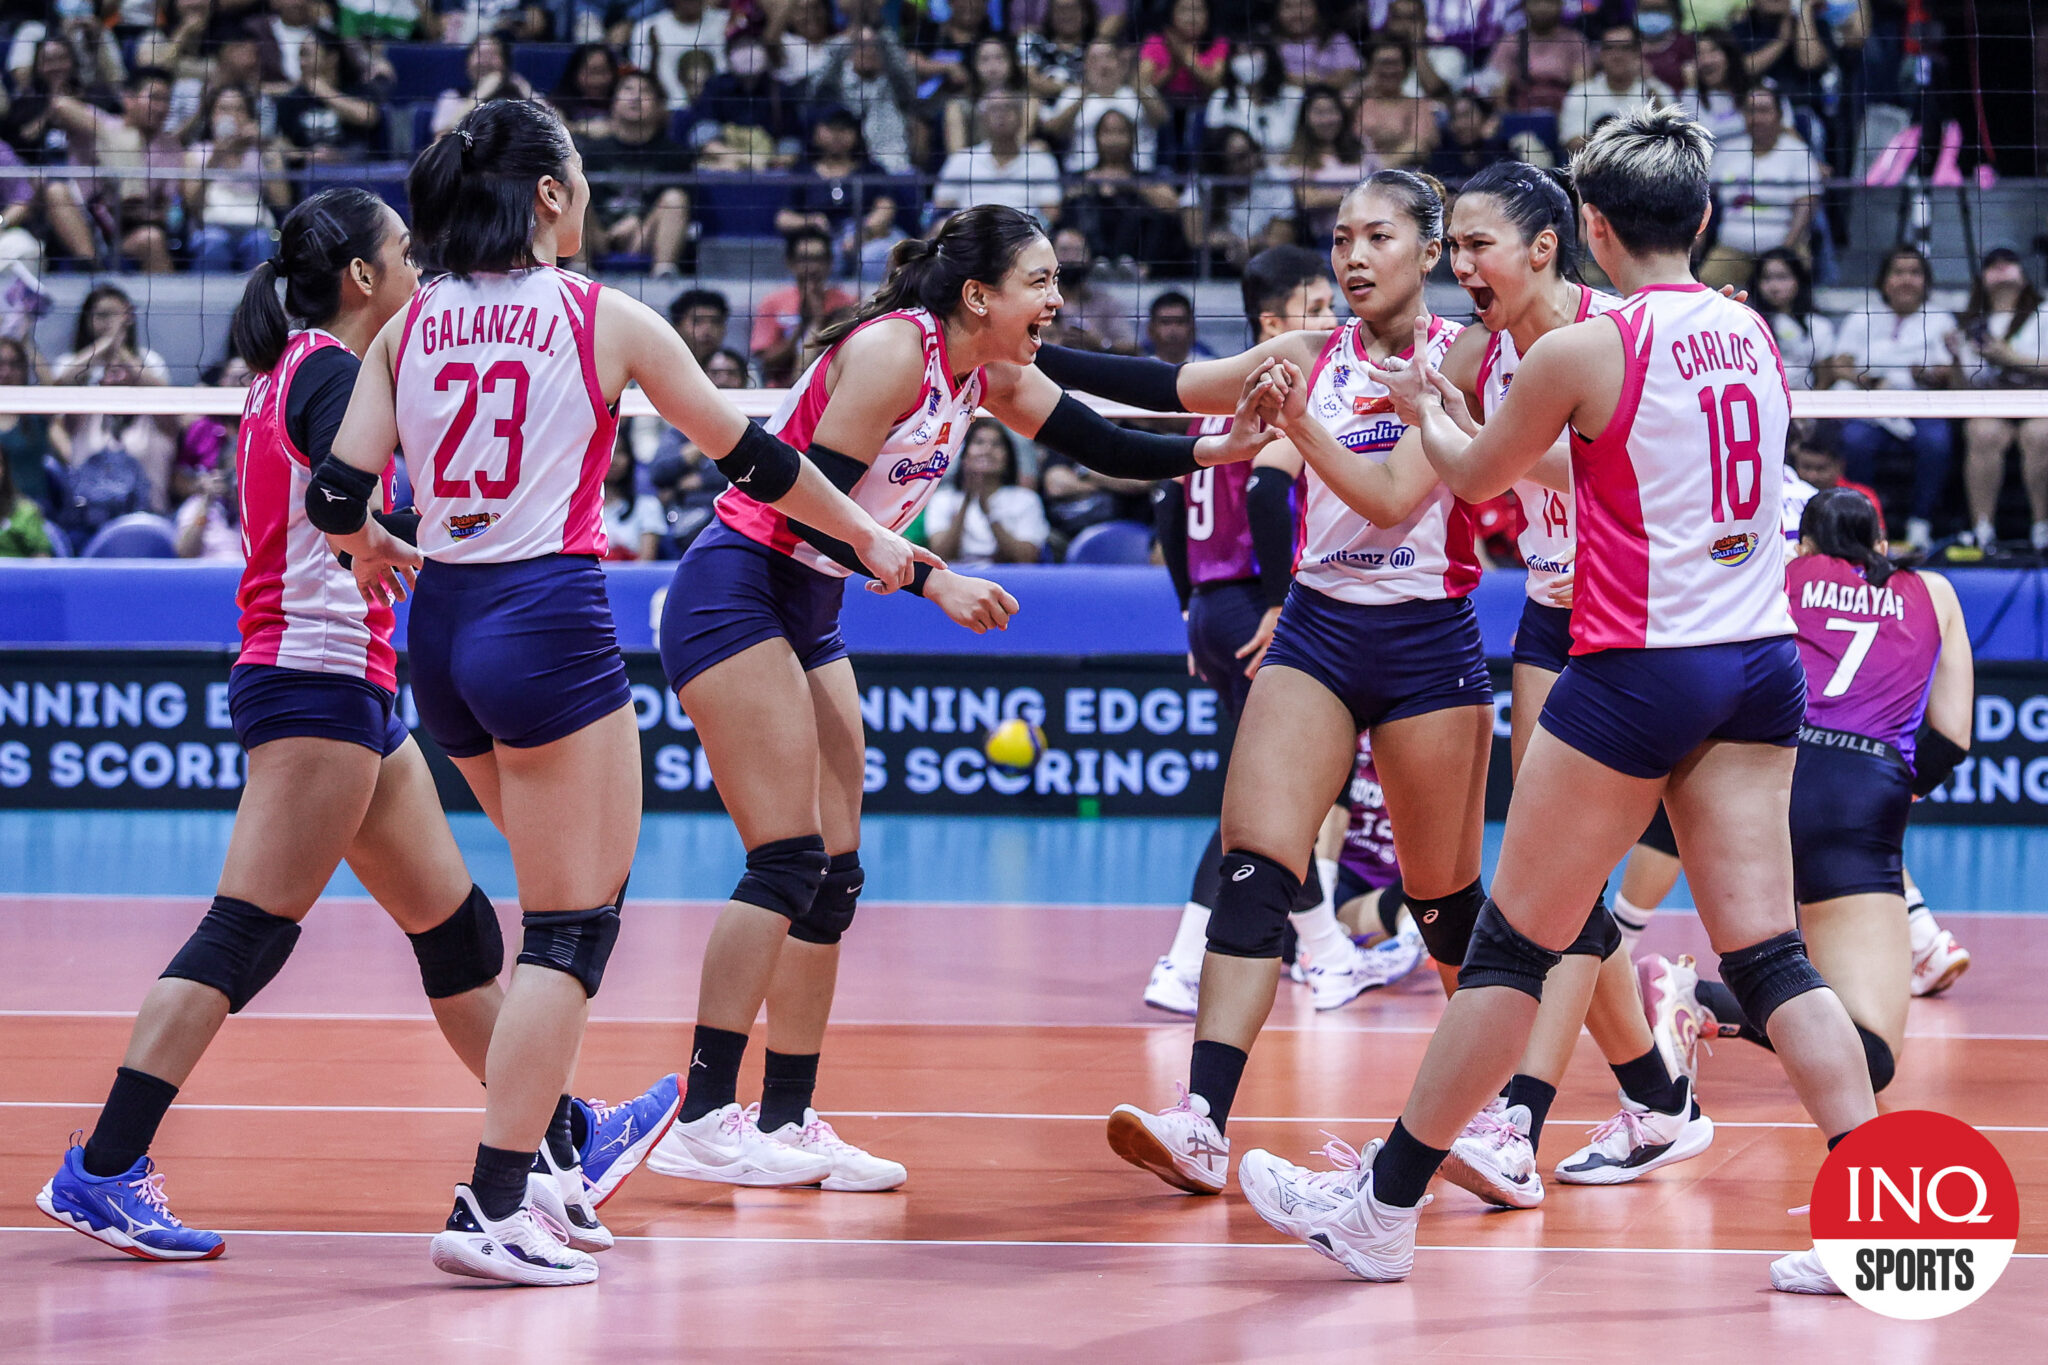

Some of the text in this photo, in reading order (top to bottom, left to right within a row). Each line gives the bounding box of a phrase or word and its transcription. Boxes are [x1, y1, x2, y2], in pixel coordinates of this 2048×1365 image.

[422, 305, 559, 357] GALANZA J.
[1671, 331, 1758, 380] CARLOS
[433, 360, 531, 499] 23
[1697, 383, 1762, 523] 18
[1187, 465, 1214, 541] 9
[1542, 488, 1568, 538] 14
[1822, 617, 1880, 697] 7
[0, 681, 188, 729] NNING
[859, 686, 1219, 735] NNING EDGE
[1975, 694, 2048, 743] DG
[50, 741, 248, 789] SCORI
